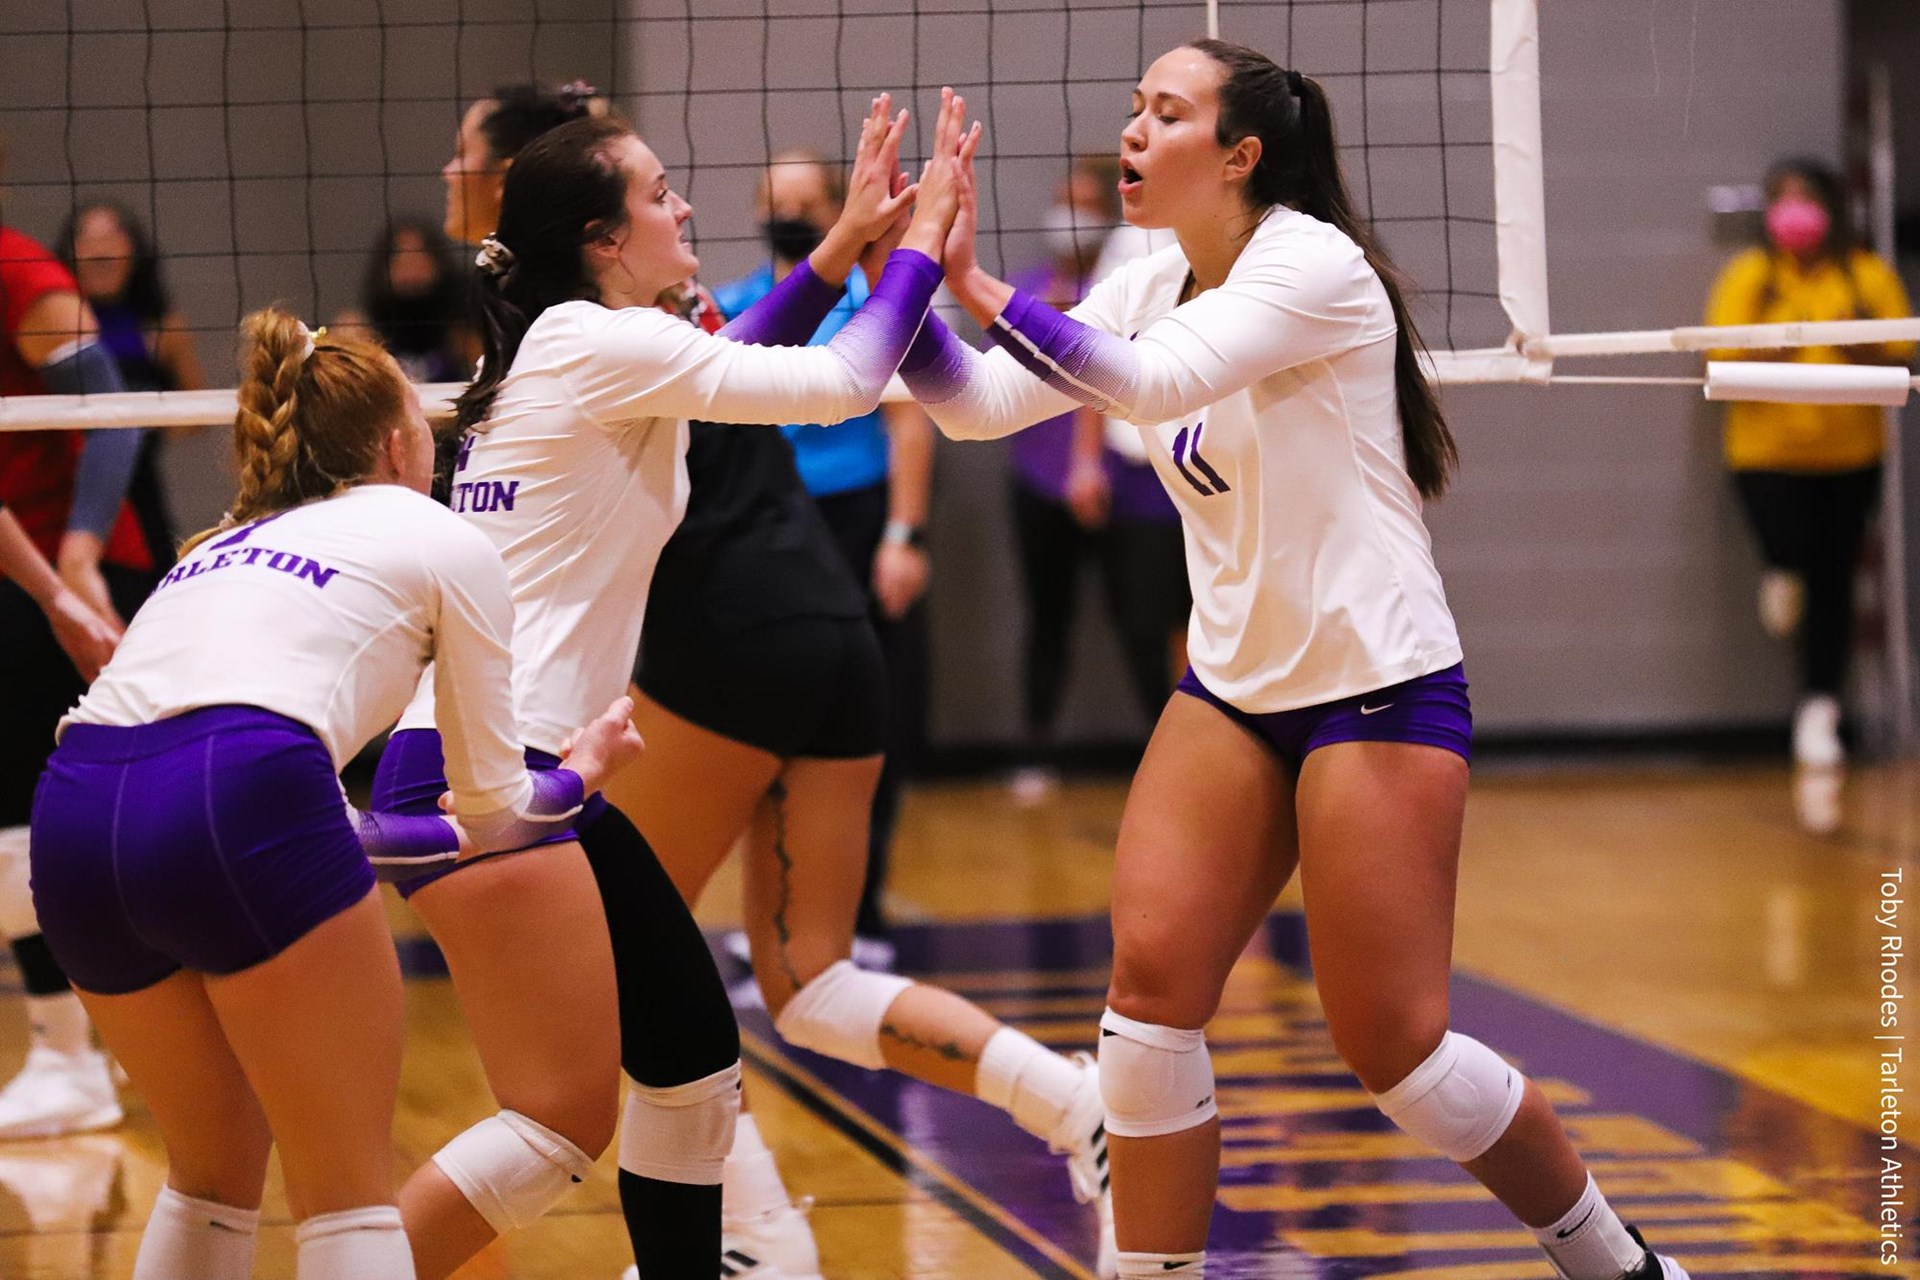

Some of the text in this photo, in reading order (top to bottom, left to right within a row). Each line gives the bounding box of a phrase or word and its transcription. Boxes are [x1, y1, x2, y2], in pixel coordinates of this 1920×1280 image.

[1172, 422, 1231, 497] 11
[451, 481, 520, 513] TON
[150, 547, 340, 593] RLETON
